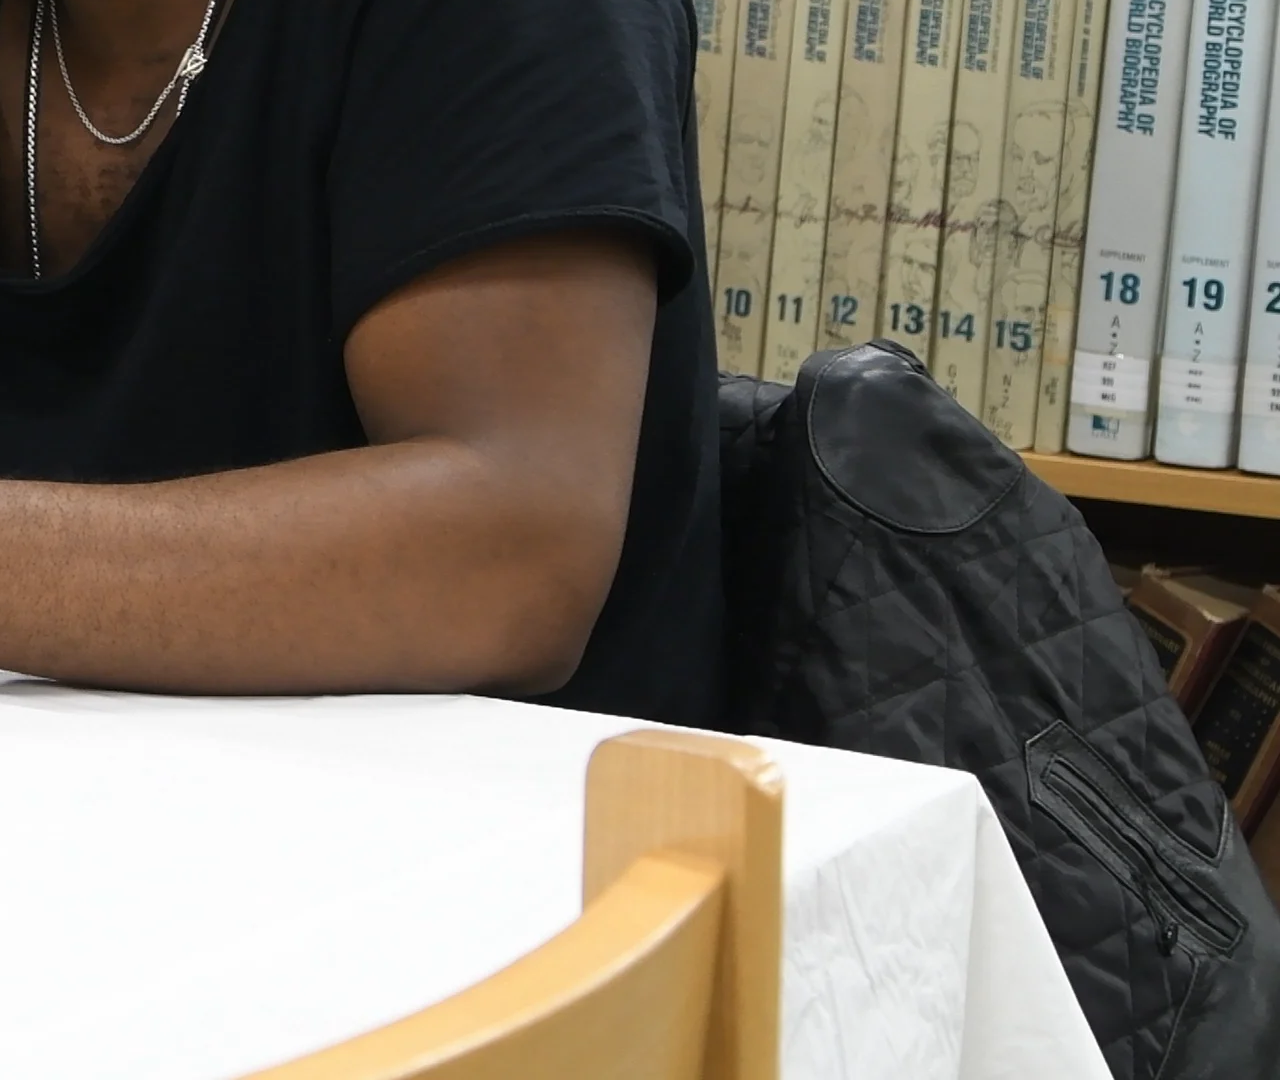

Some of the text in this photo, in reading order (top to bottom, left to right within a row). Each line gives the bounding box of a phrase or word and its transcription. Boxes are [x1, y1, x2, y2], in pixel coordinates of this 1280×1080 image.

[744, 2, 760, 57] BIOGRAPHY
[804, 6, 820, 62] BIOGRAPHY
[852, 5, 871, 61] BIOGRAPHY
[914, 9, 931, 67] BIOGRAPHY
[963, 14, 981, 72] BIOGRAPHY
[700, 39, 711, 53] OF
[756, 45, 767, 58] OF
[817, 50, 827, 63] OF
[865, 49, 876, 63] OF
[927, 53, 939, 68] OF
[1020, 21, 1037, 79] BIOGRAPHY
[976, 60, 987, 73] OF
[1032, 66, 1044, 81] OF
[1117, 38, 1144, 134] BIOGRAPHY
[1198, 41, 1224, 139] BIOGRAPHY
[1136, 114, 1155, 136] OF
[1218, 118, 1237, 141] OF
[1100, 249, 1146, 262] SUPPLEMENT
[724, 288, 752, 317] 10
[1100, 271, 1140, 305] 18
[1183, 277, 1224, 311] 19
[1265, 282, 1280, 313] 2
[778, 294, 803, 324] 11
[831, 294, 858, 325] 12
[890, 303, 925, 335] 13
[941, 309, 975, 343] 14
[996, 320, 1032, 352] 15
